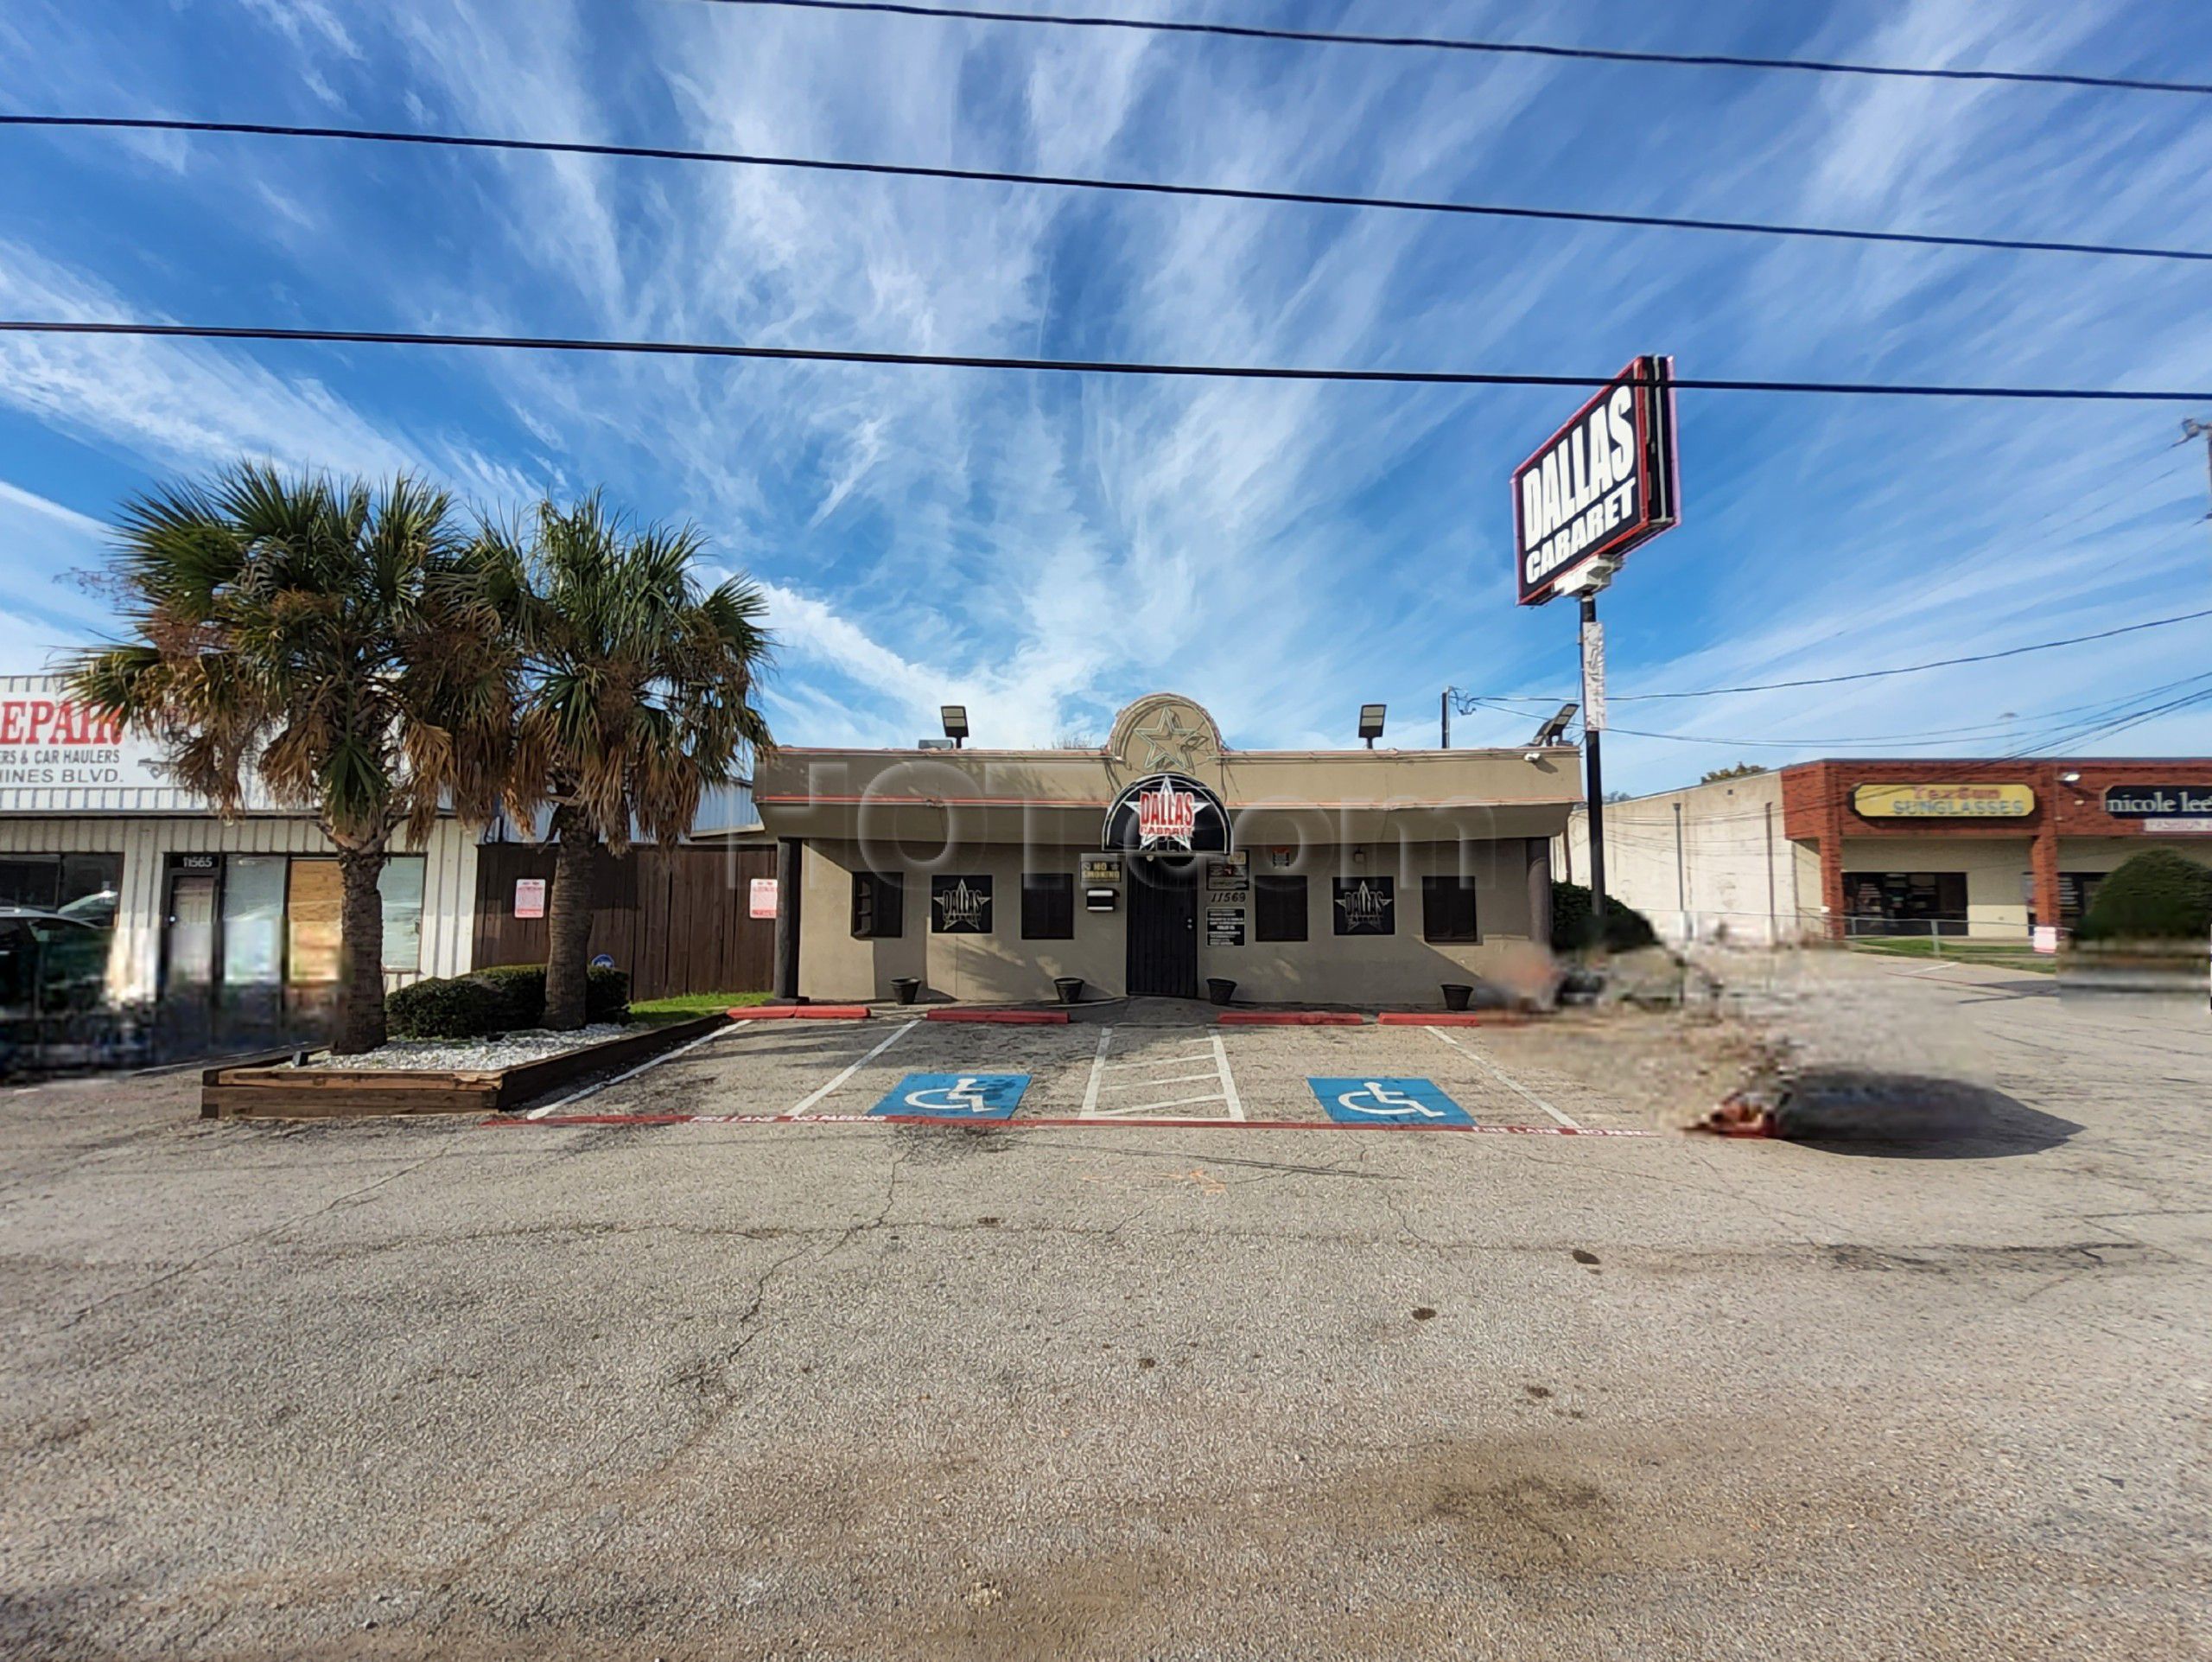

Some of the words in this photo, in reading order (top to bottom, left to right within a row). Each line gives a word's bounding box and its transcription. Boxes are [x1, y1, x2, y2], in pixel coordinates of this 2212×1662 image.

[1522, 385, 1635, 551] DALLAS
[1525, 478, 1636, 584] CABARET
[20, 750, 28, 764] &
[35, 750, 59, 764] CAR
[63, 749, 120, 764] HAULERS
[0, 768, 54, 783] INES
[62, 768, 124, 783] BLVD.
[1141, 793, 1195, 826] DALLAS
[1893, 800, 2024, 815] SUNGLASSES
[2107, 792, 2177, 812] nicole
[183, 856, 213, 868] 11565
[943, 890, 982, 914] DALLAS
[1211, 893, 1246, 903] 11569
[1344, 891, 1384, 915] DALLAS
